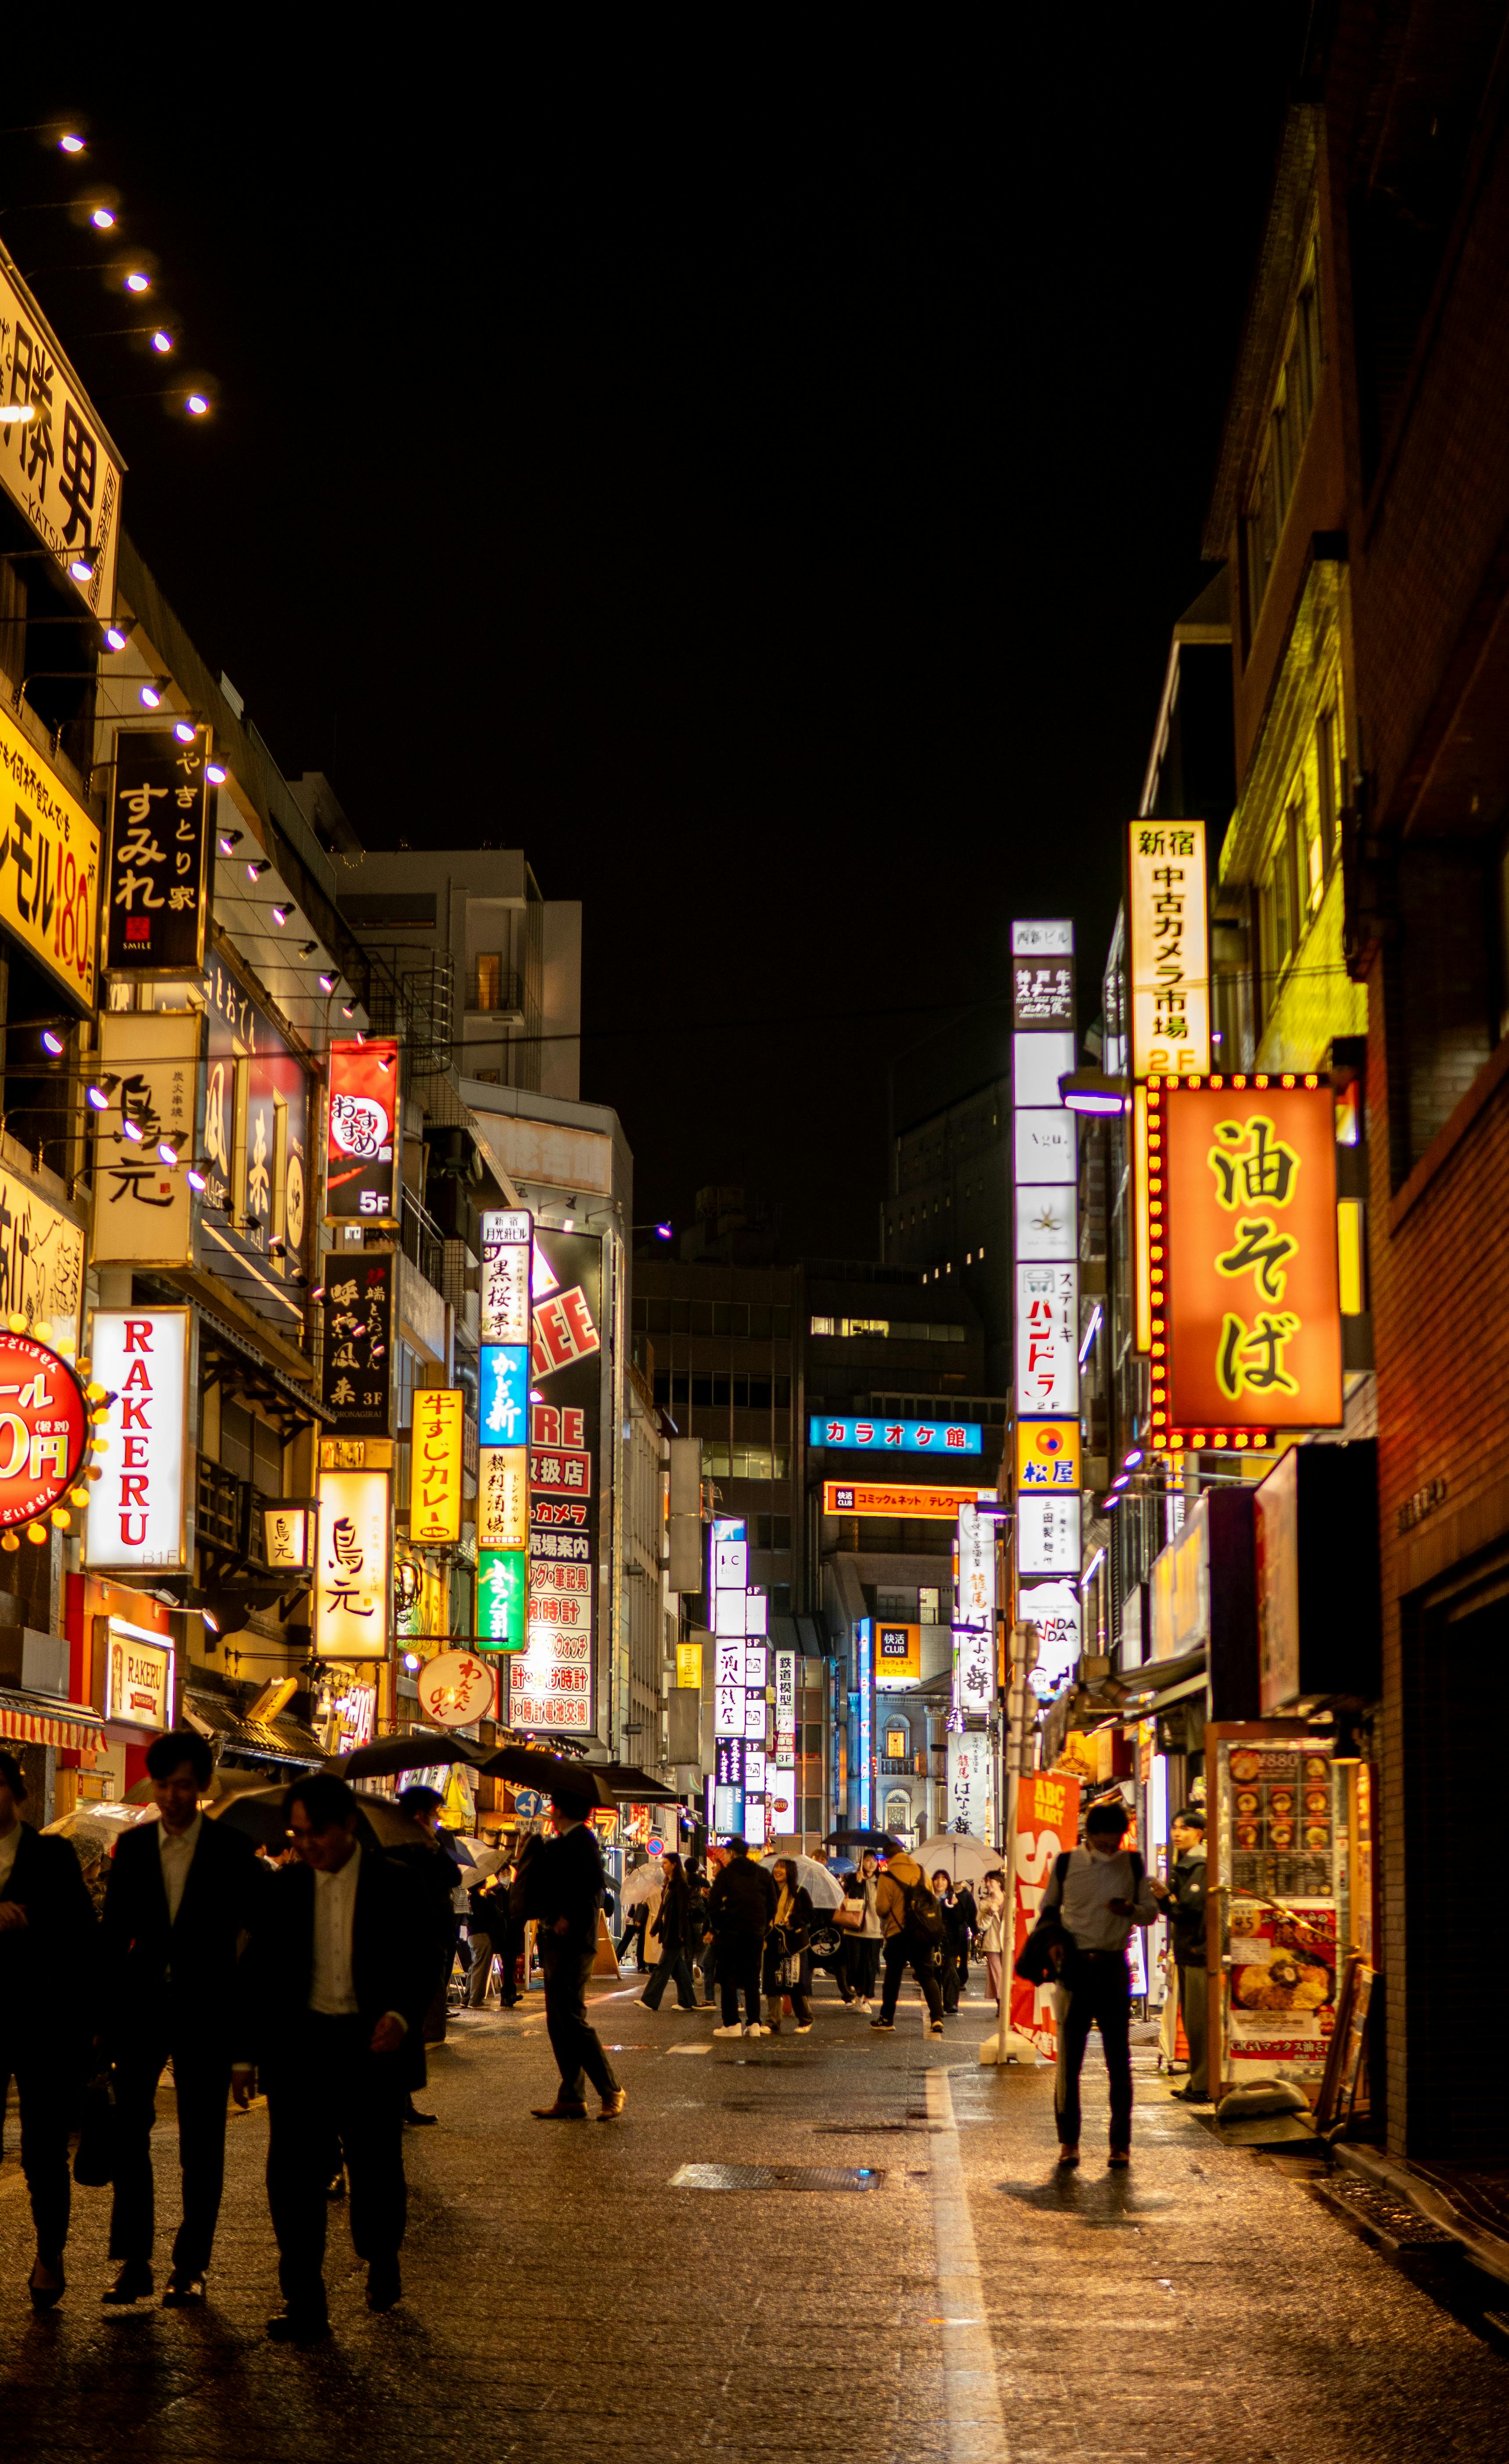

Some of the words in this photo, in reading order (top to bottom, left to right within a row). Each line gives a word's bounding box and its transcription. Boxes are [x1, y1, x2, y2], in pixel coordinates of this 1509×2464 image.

[168, 752, 200, 910] やきとり家
[1138, 830, 1195, 856] 新宿
[115, 783, 169, 910] すみれ
[54, 840, 89, 979] 180
[123, 942, 152, 950] SMILE
[1151, 866, 1188, 1039] 中古カメラ市場
[1017, 984, 1070, 996] ステーキ
[1149, 1048, 1194, 1071] 2F
[359, 1191, 389, 1214] 5F
[495, 1216, 518, 1226] 新宿
[484, 1247, 497, 1259] 3F
[1208, 1115, 1301, 1399] 油そば
[488, 1259, 512, 1336] 黒桜亭
[1059, 1273, 1073, 1342] ステーキ
[1024, 1299, 1055, 1398] パンドラ
[363, 1392, 382, 1405] 3F
[119, 1320, 153, 1546] RAKERU
[827, 1422, 965, 1448] カラオケ館
[421, 1393, 455, 1522] 牛すじカレー
[1023, 1460, 1074, 1483] 松屋
[486, 1453, 506, 1533] 熱烈酒場
[511, 1473, 520, 1522] ドンちゃん
[837, 1491, 853, 1499] 快活
[274, 1516, 295, 1559] 鳥元
[529, 1534, 589, 1559] 売場案内
[142, 1550, 178, 1564] B1F
[326, 1517, 374, 1616] 鳥元
[747, 1586, 760, 1595] 6F
[1035, 1617, 1077, 1629] ANDA
[884, 1633, 905, 1644] 快活
[884, 1645, 905, 1654] CLUB
[128, 1656, 162, 1691] RAKERU
[684, 1648, 695, 1676] miel
[779, 1657, 792, 1706] 鉄道模型
[746, 1691, 760, 1699] 4F
[746, 1743, 760, 1751] 3F
[1034, 1779, 1065, 1809] ABC
[1034, 1802, 1064, 1827] MART
[1230, 2041, 1329, 2053] GIGAマックス油そ
